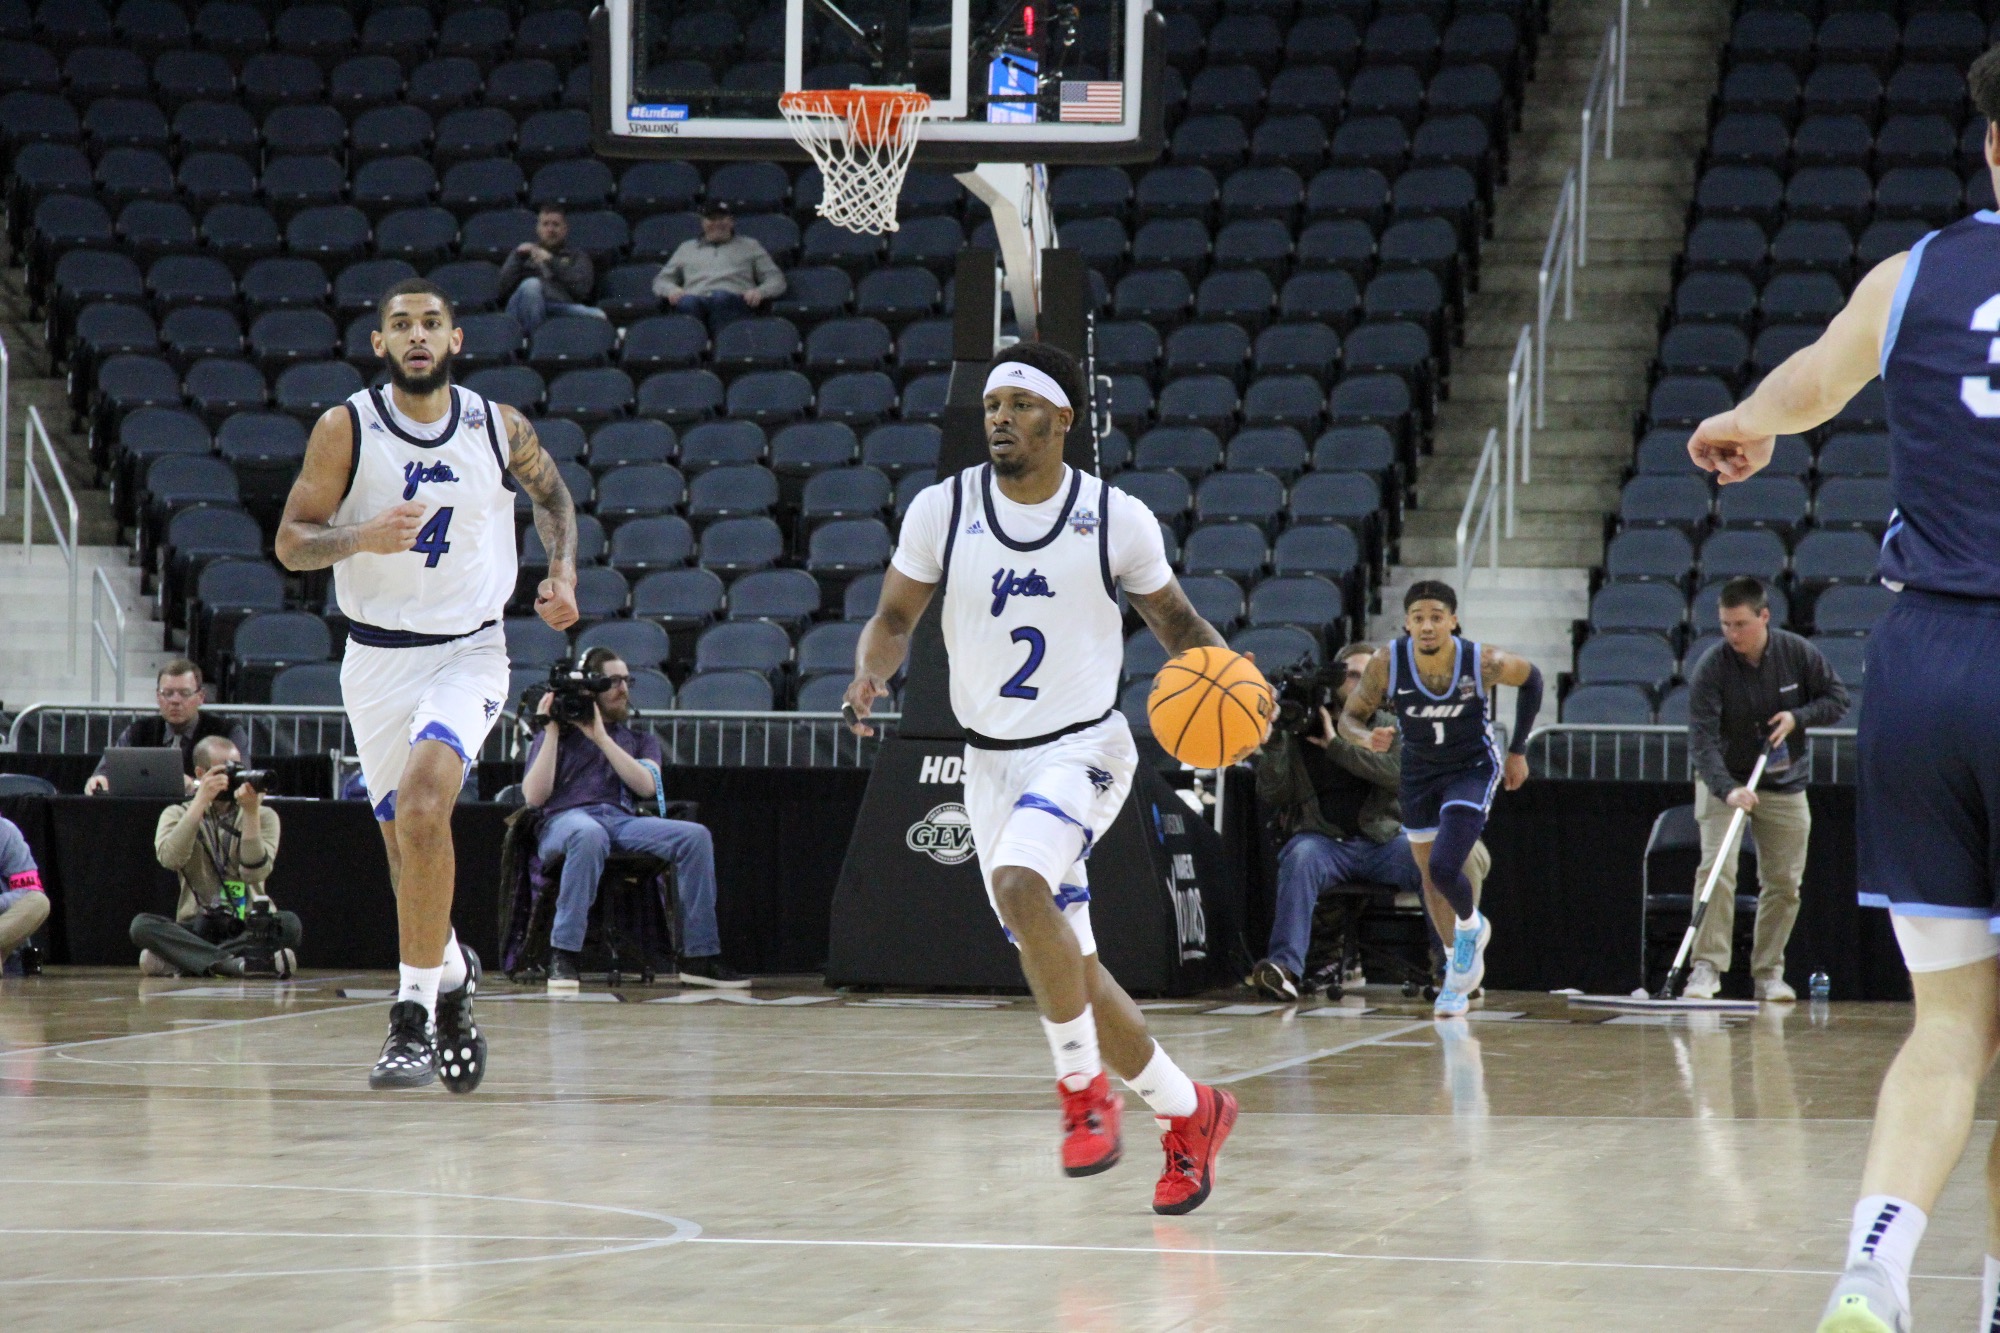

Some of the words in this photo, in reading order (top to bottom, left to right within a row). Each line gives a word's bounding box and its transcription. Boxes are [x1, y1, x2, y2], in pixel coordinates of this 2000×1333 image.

[628, 122, 679, 134] SPALDING
[409, 506, 455, 568] 4
[990, 567, 1056, 617] Yotes
[999, 625, 1046, 701] 2
[1432, 722, 1445, 745] 1
[918, 755, 968, 784] HO
